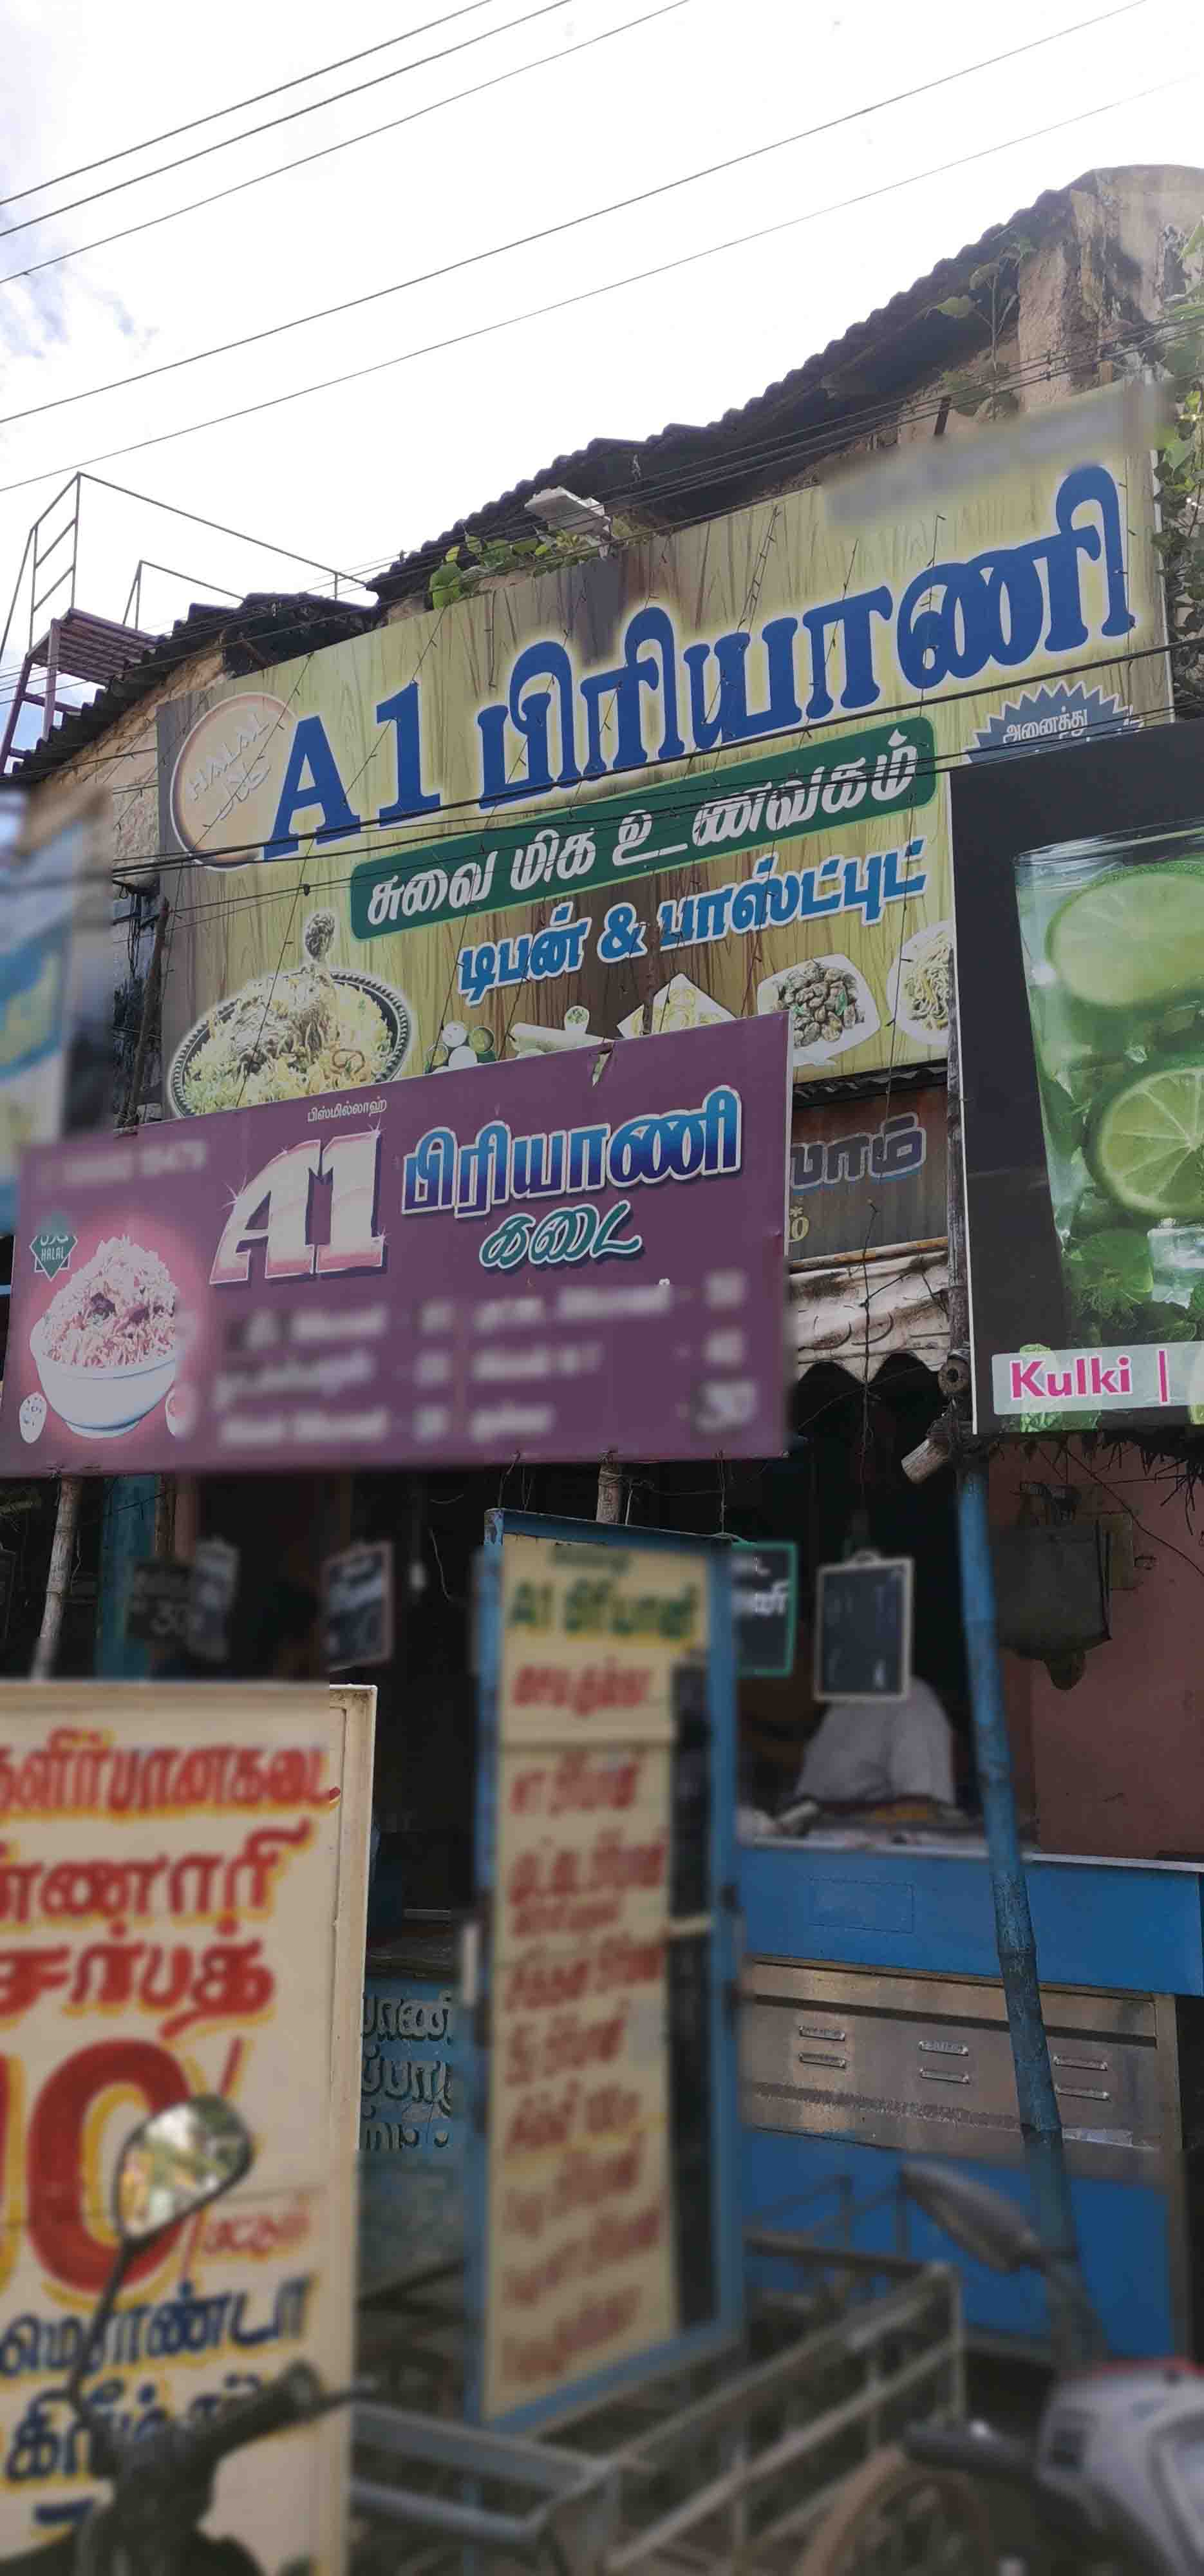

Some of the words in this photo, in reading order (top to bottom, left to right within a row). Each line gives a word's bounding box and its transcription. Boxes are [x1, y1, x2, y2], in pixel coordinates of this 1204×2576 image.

[263, 680, 441, 860] A1
[477, 464, 1136, 809] பிரியாணி
[368, 850, 498, 926] சுவை
[510, 827, 597, 892] மிக
[612, 729, 919, 866] உணவகம்
[460, 904, 591, 1005] டிபன்
[597, 903, 648, 963] &
[659, 836, 927, 951] பாஸ்ட்புட்
[209, 1128, 386, 1288] A1
[402, 1085, 742, 1218] பிரியாணி
[479, 1200, 643, 1269] கடை
[1010, 1354, 1133, 1400] Kulki
